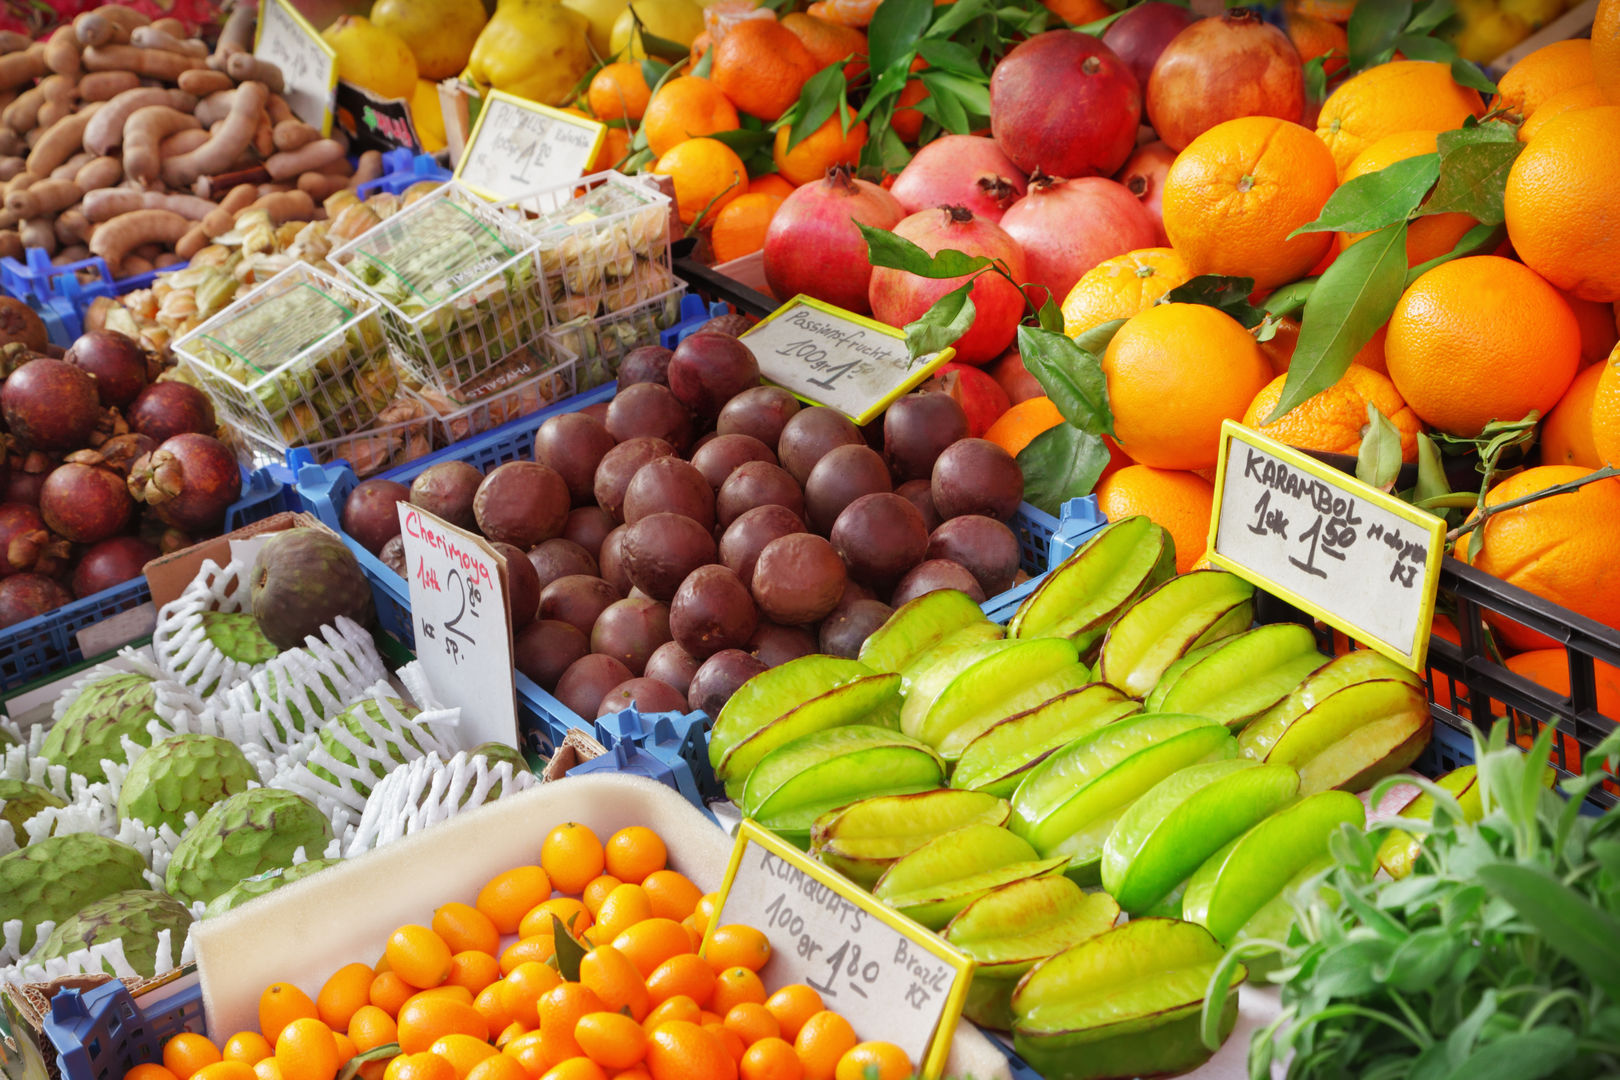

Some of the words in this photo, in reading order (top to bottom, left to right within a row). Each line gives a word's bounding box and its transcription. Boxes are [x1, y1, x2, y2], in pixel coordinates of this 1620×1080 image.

[433, 254, 498, 292] PHYSAL
[776, 339, 829, 375] 100gr
[785, 311, 892, 360] Passionsfrucht
[466, 363, 531, 398] PHYSALIS
[1244, 448, 1363, 526] KARAMBOL
[406, 511, 494, 590] Cherimoya
[760, 850, 869, 933] KUMQUATS
[893, 937, 949, 993] Brazil
[764, 893, 824, 961] 100gr
